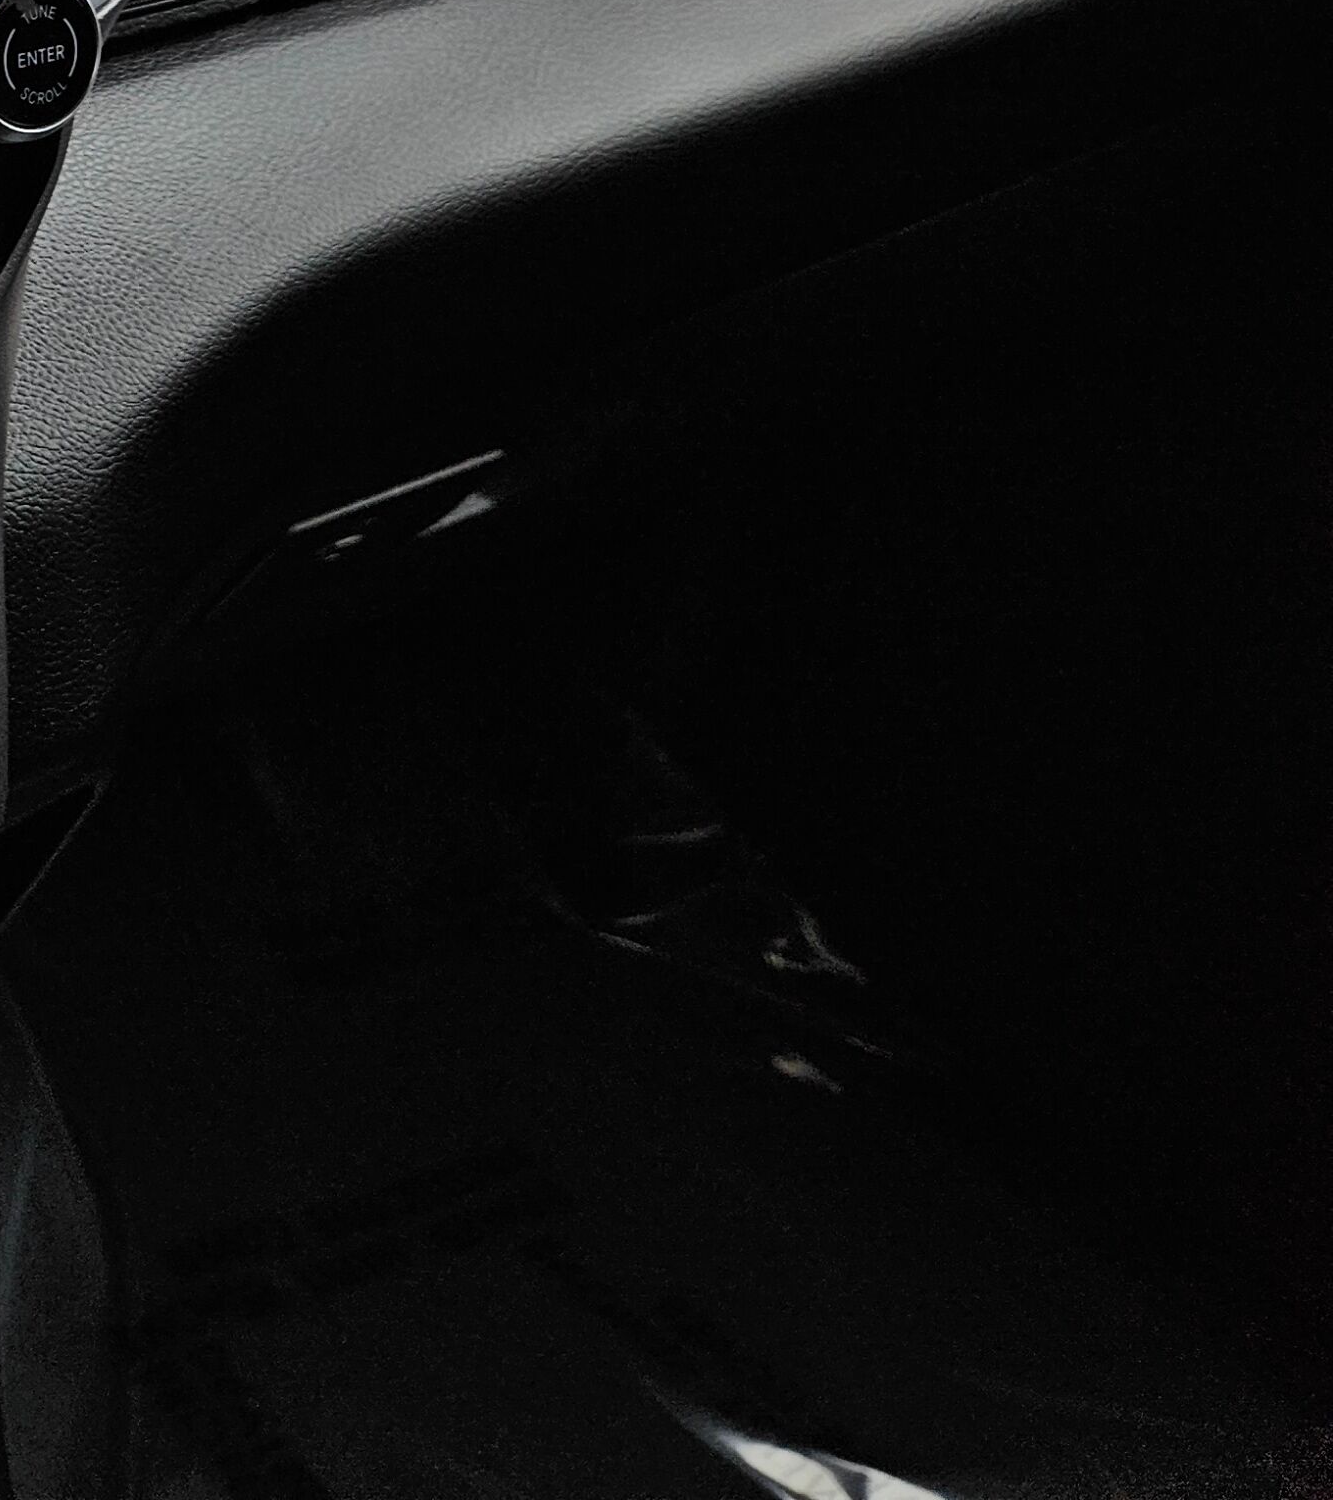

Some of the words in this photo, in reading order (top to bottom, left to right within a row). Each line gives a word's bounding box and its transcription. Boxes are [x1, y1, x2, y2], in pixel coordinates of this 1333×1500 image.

[21, 3, 58, 25] TUNE
[17, 44, 66, 69] ENTER
[19, 81, 69, 105] SCROLL
